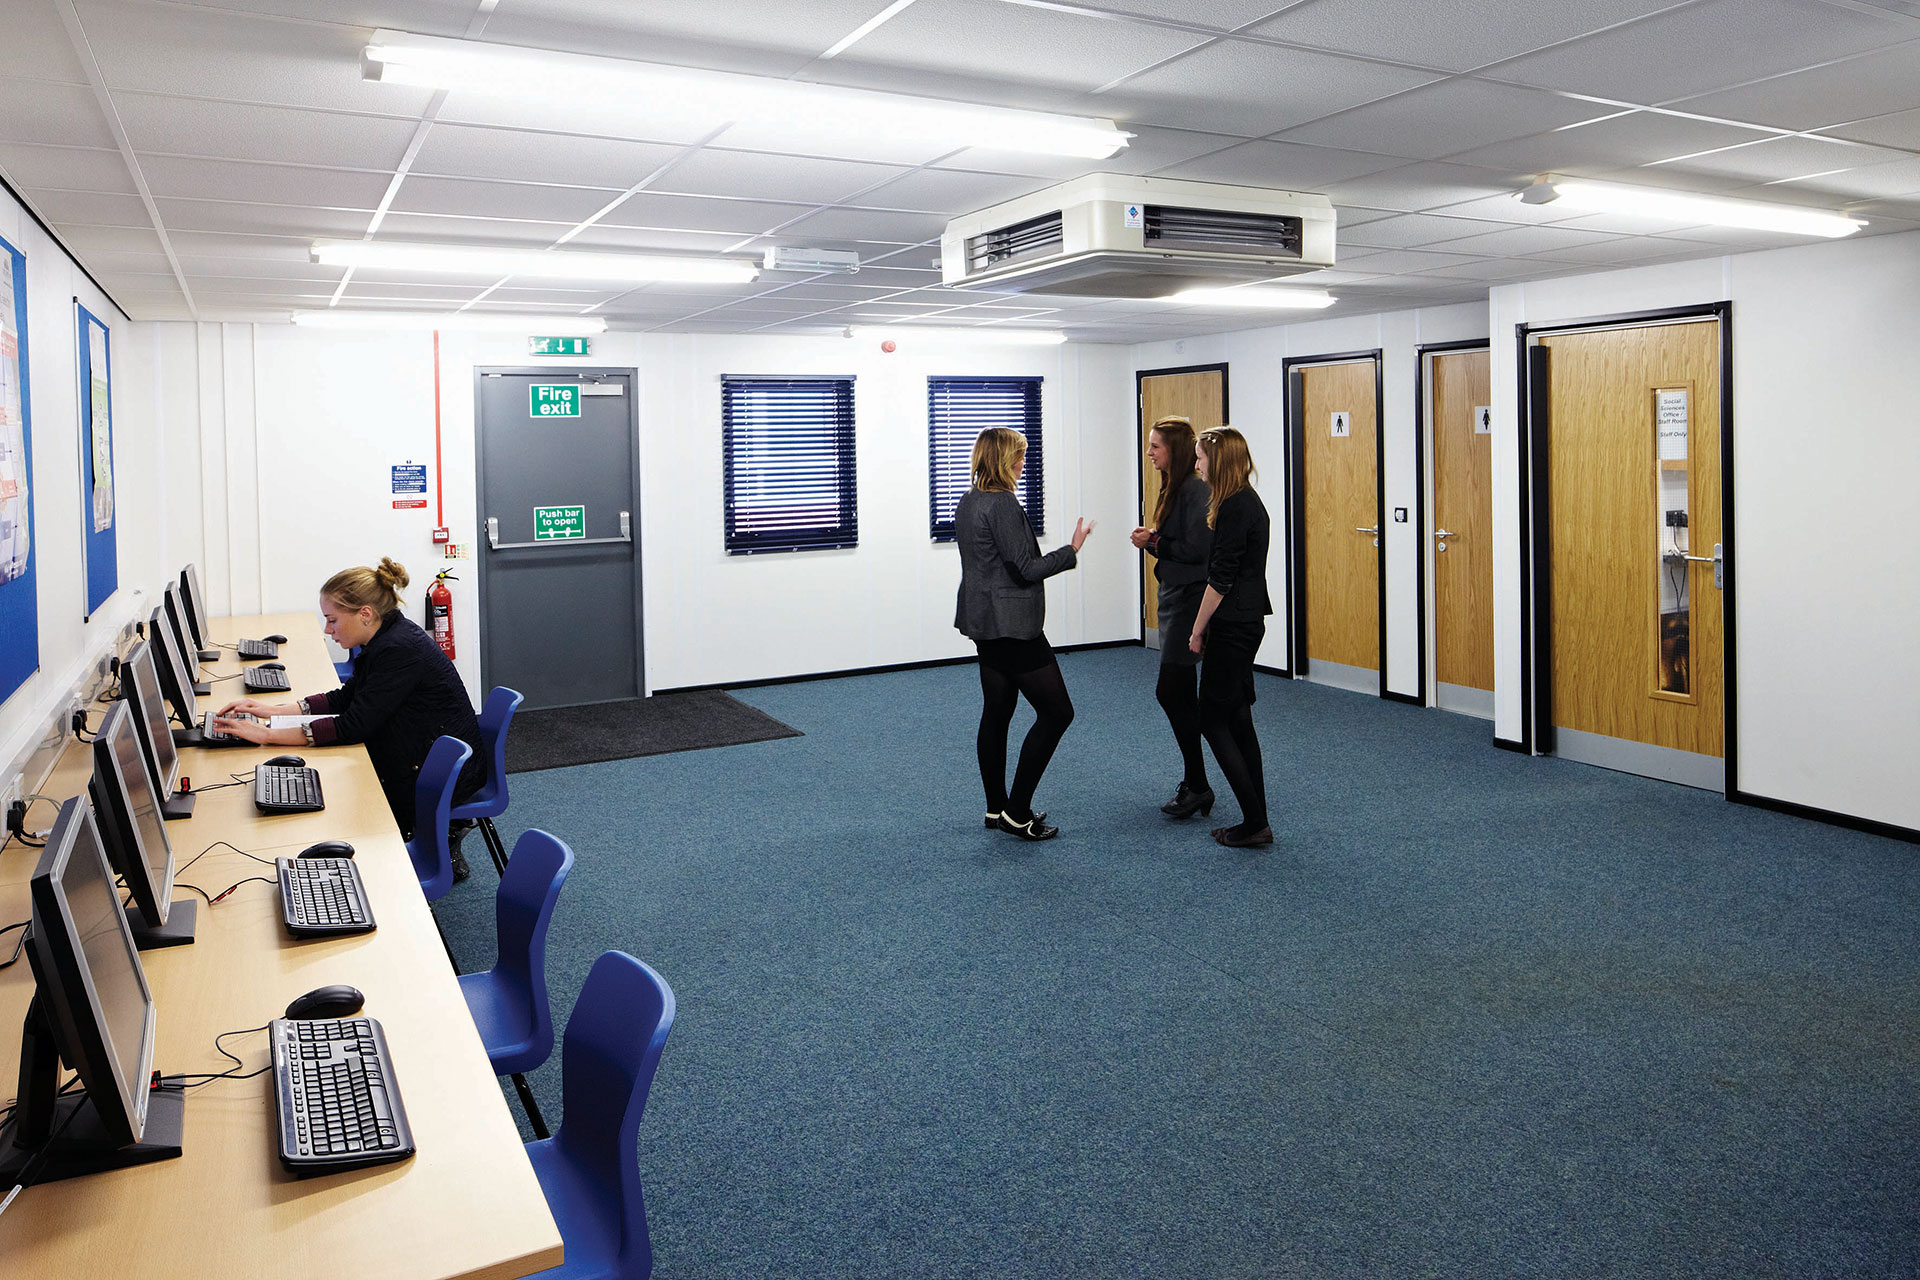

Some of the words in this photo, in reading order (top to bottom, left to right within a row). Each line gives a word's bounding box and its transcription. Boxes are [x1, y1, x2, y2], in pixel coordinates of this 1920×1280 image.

[539, 387, 572, 400] Fire
[540, 401, 572, 415] exit
[539, 510, 563, 518] Push
[565, 509, 580, 517] bar
[554, 518, 577, 526] open
